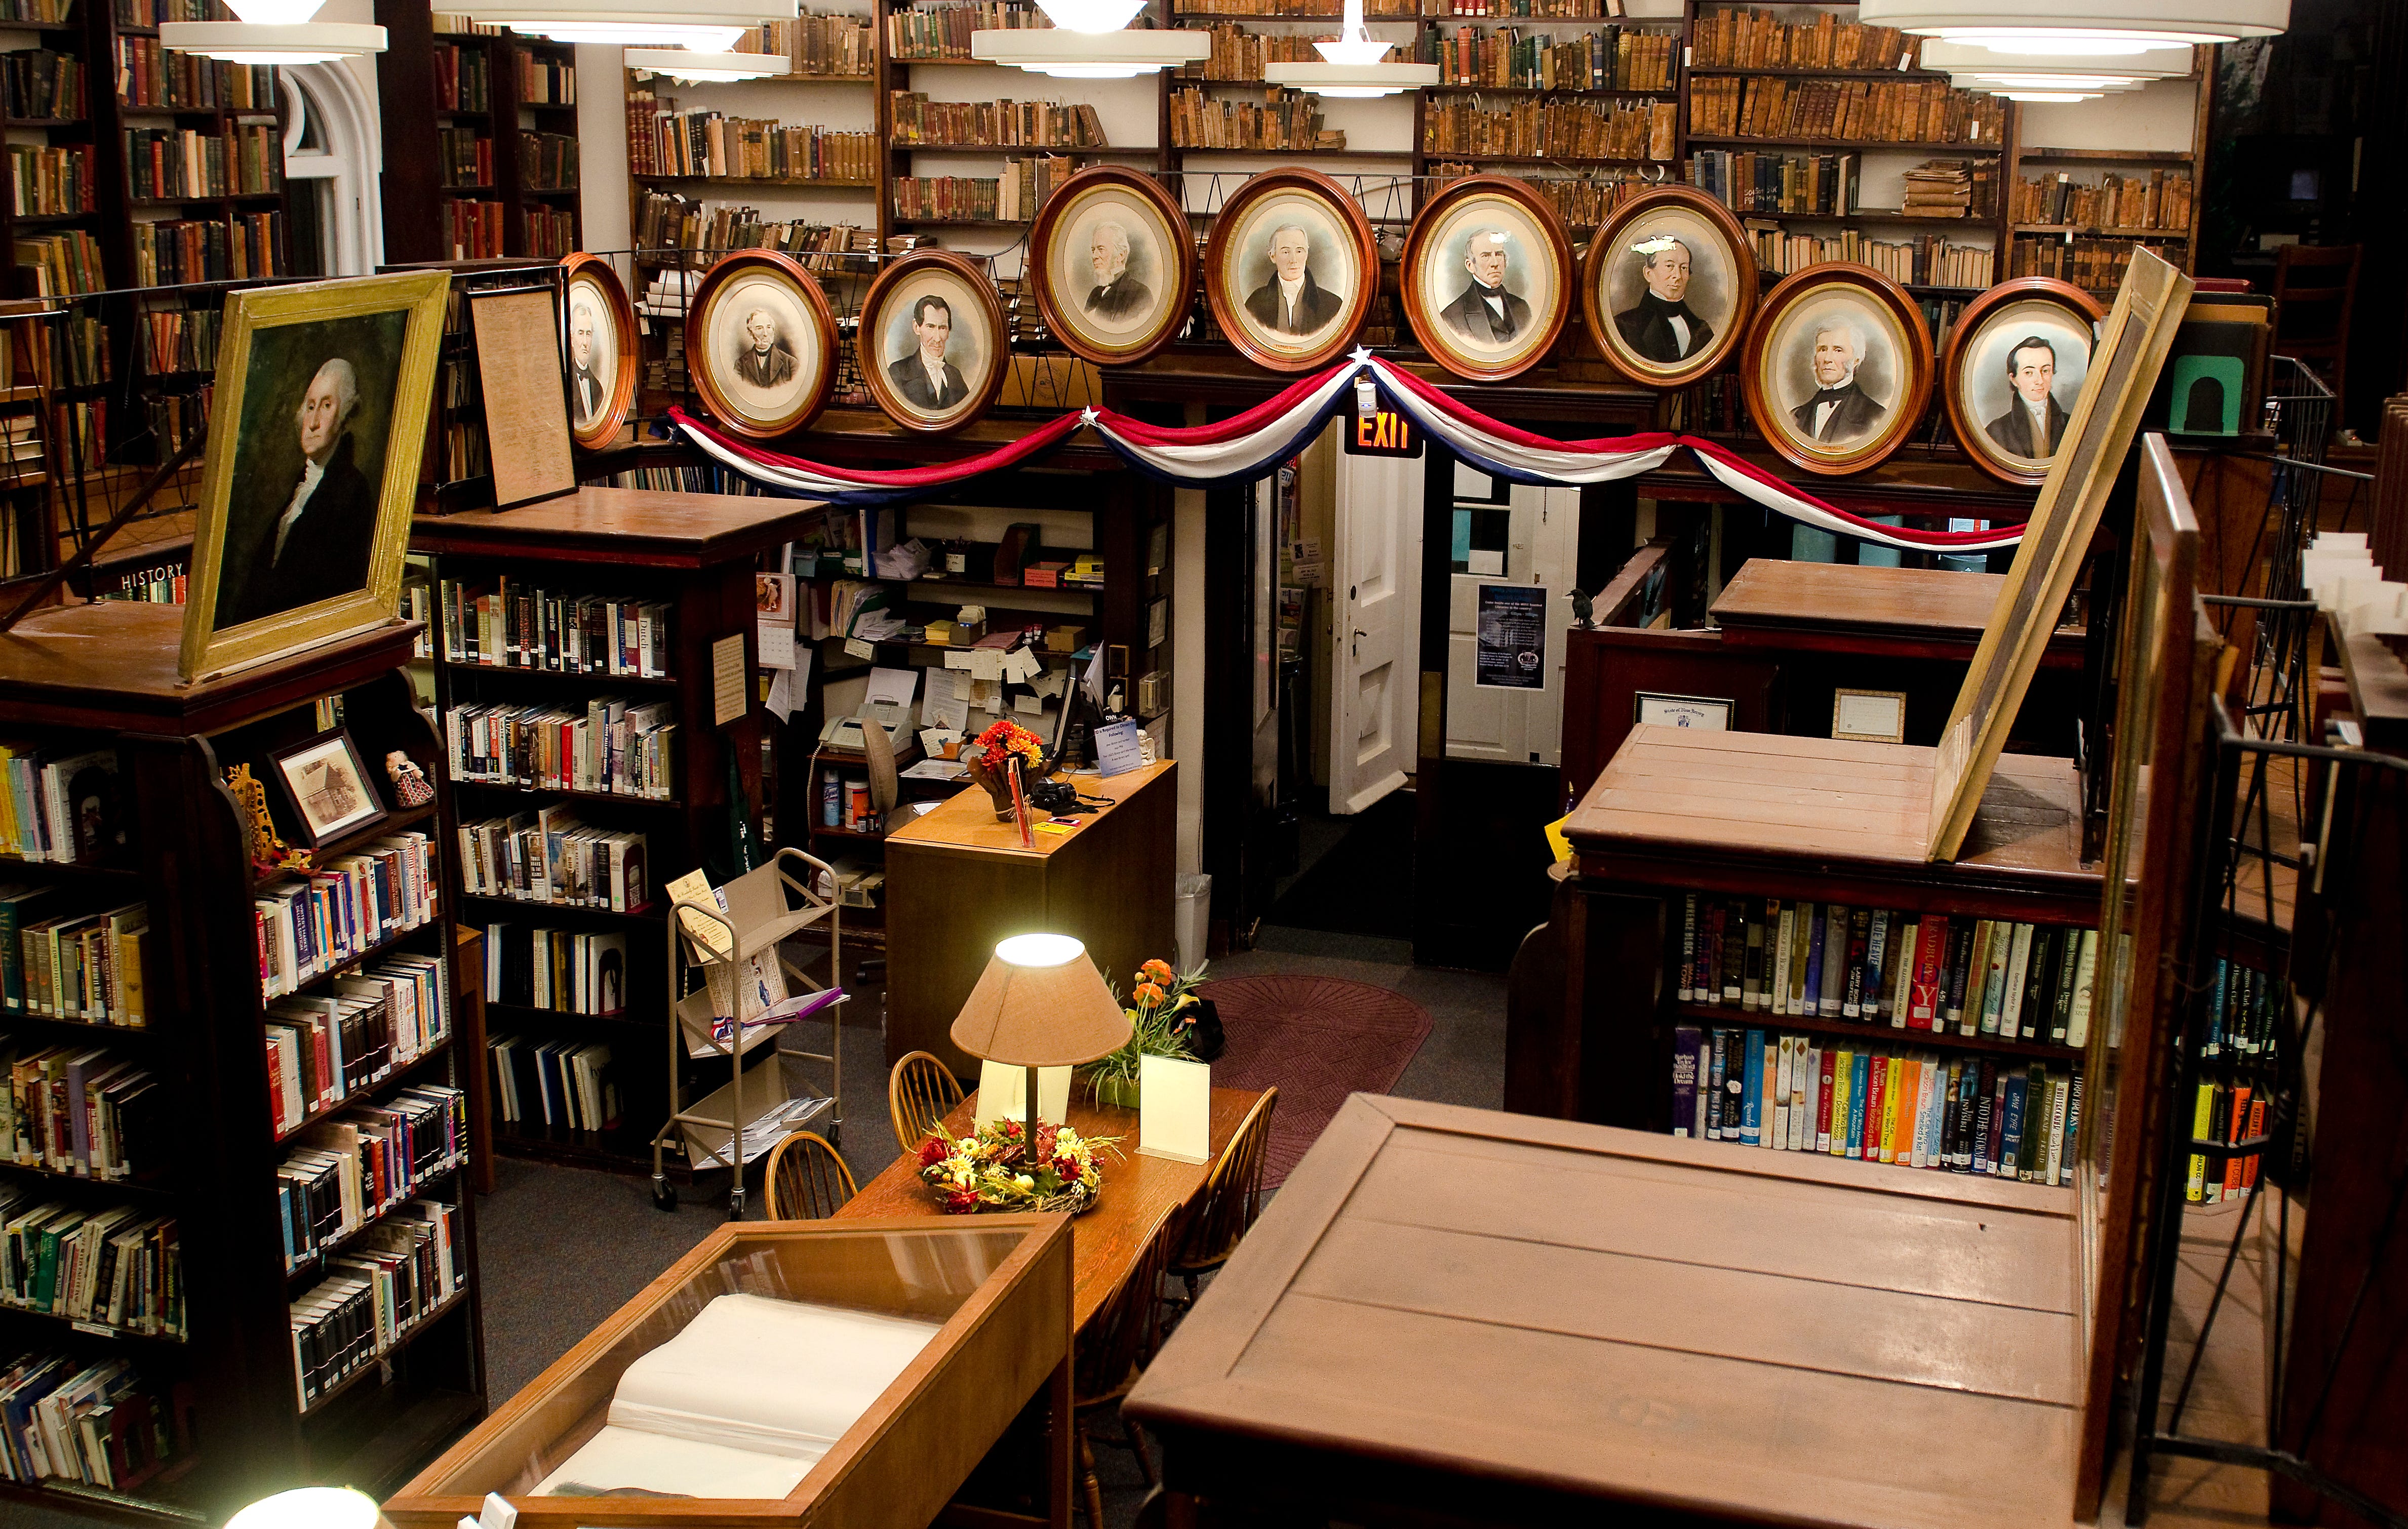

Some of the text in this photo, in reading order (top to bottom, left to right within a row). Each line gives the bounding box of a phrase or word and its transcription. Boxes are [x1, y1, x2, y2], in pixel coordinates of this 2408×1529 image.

[122, 563, 182, 589] HISTORY
[640, 620, 649, 649] Dutch
[1684, 894, 1696, 955] LAWRENCE BLOCK
[1870, 917, 1884, 969] BLUE HEAVEN
[1899, 968, 1907, 1001] ILLUSTRATED
[2240, 968, 2252, 1035] iggins Clark ZAPP
[1871, 1061, 1881, 1107] Jackson Braun
[1960, 1099, 1968, 1133] INVISIBLE
[1979, 1096, 1991, 1116] INTO
[2009, 1093, 2020, 1130] JANE EYRE
[2053, 1101, 2063, 1130] BROOKNER
[2070, 1076, 2083, 1127] TERRY BROOKS
[1918, 1111, 1926, 1135] Smelled
[1977, 1117, 1989, 1131] THE
[2042, 1104, 2051, 1132] BROOKNER
[2253, 1107, 2262, 1127] HARLAN
[1975, 1133, 1988, 1158] STORM
